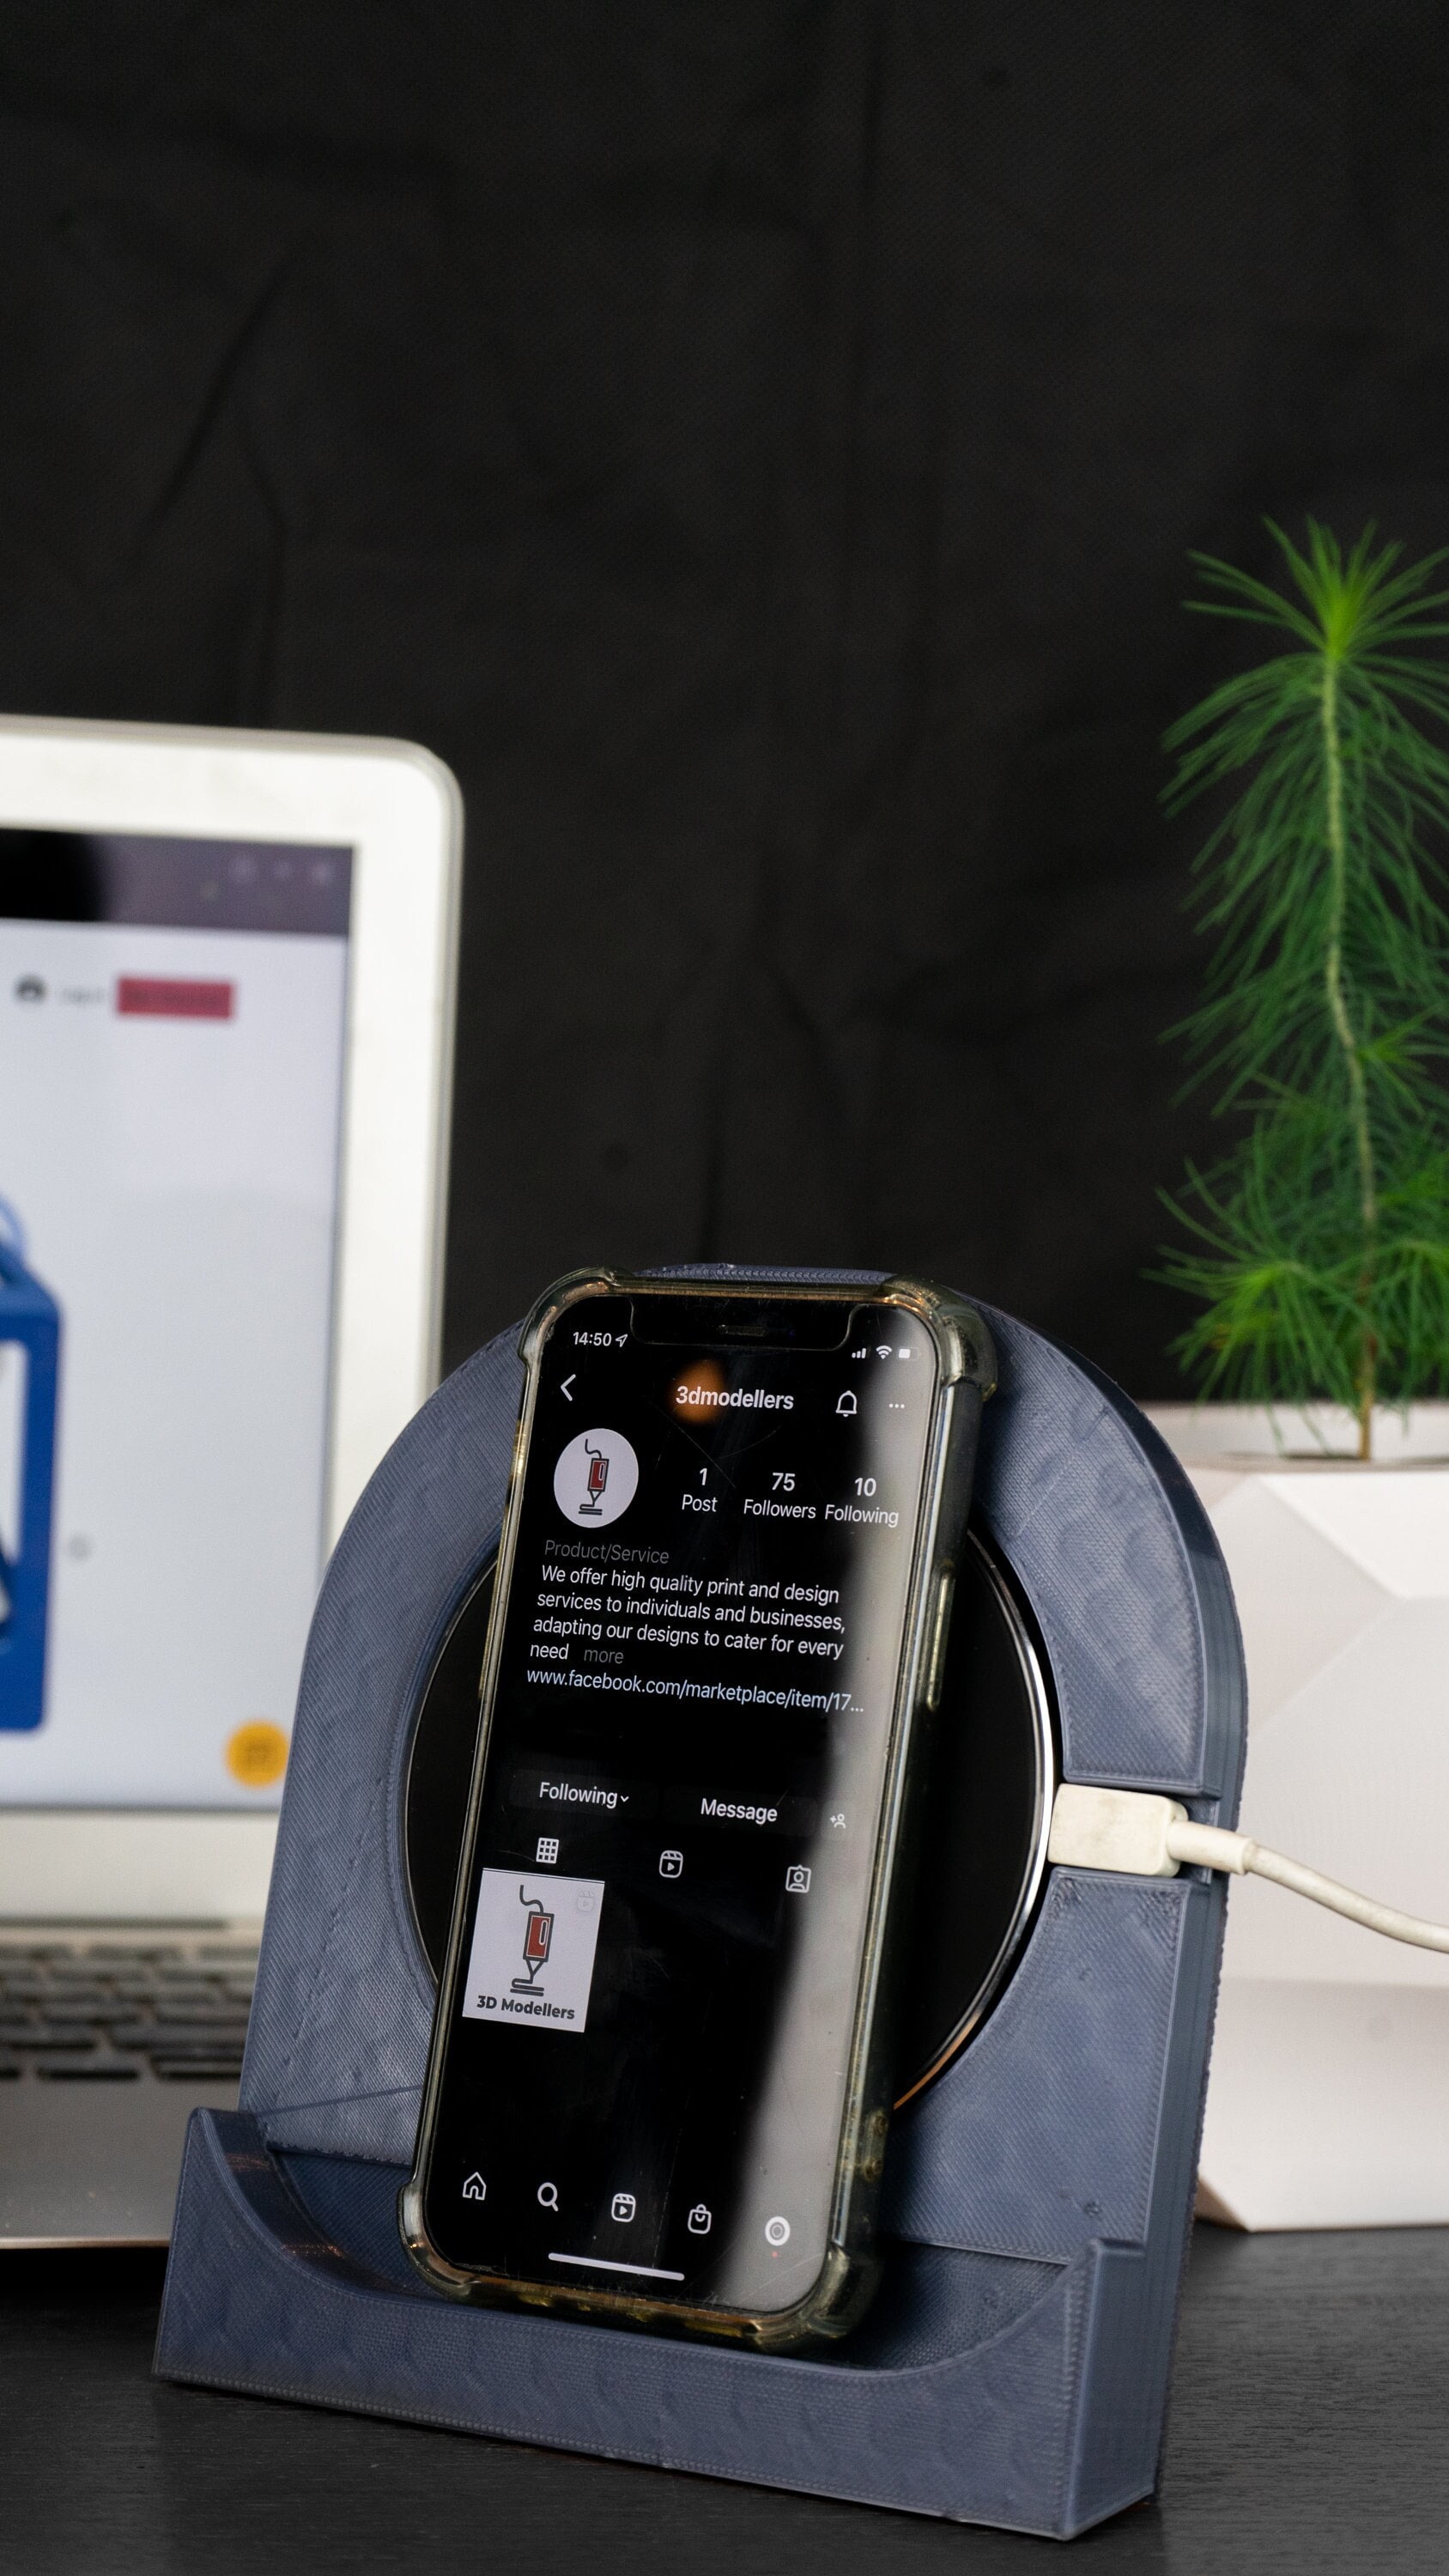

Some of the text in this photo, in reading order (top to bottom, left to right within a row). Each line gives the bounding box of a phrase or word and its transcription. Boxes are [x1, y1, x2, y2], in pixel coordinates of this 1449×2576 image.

[573, 1331, 612, 1347] 14:50
[676, 1386, 794, 1410] 3dmodellers
[699, 1468, 708, 1486] 1
[772, 1473, 796, 1491] 75
[854, 1478, 876, 1497] 10
[682, 1495, 718, 1513] Post
[743, 1498, 816, 1520] Followers
[825, 1504, 899, 1528] Following
[545, 1540, 669, 1564] Product/Service
[542, 1564, 839, 1603] We offer high quality print and design
[537, 1593, 846, 1633] services to individuals and businesses,
[533, 1618, 844, 1661] adapting our designs to cater for every
[530, 1643, 624, 1664] need more
[539, 1782, 617, 1808] Following
[700, 1798, 778, 1825] Message
[476, 1996, 575, 2020] 3D Modellers
